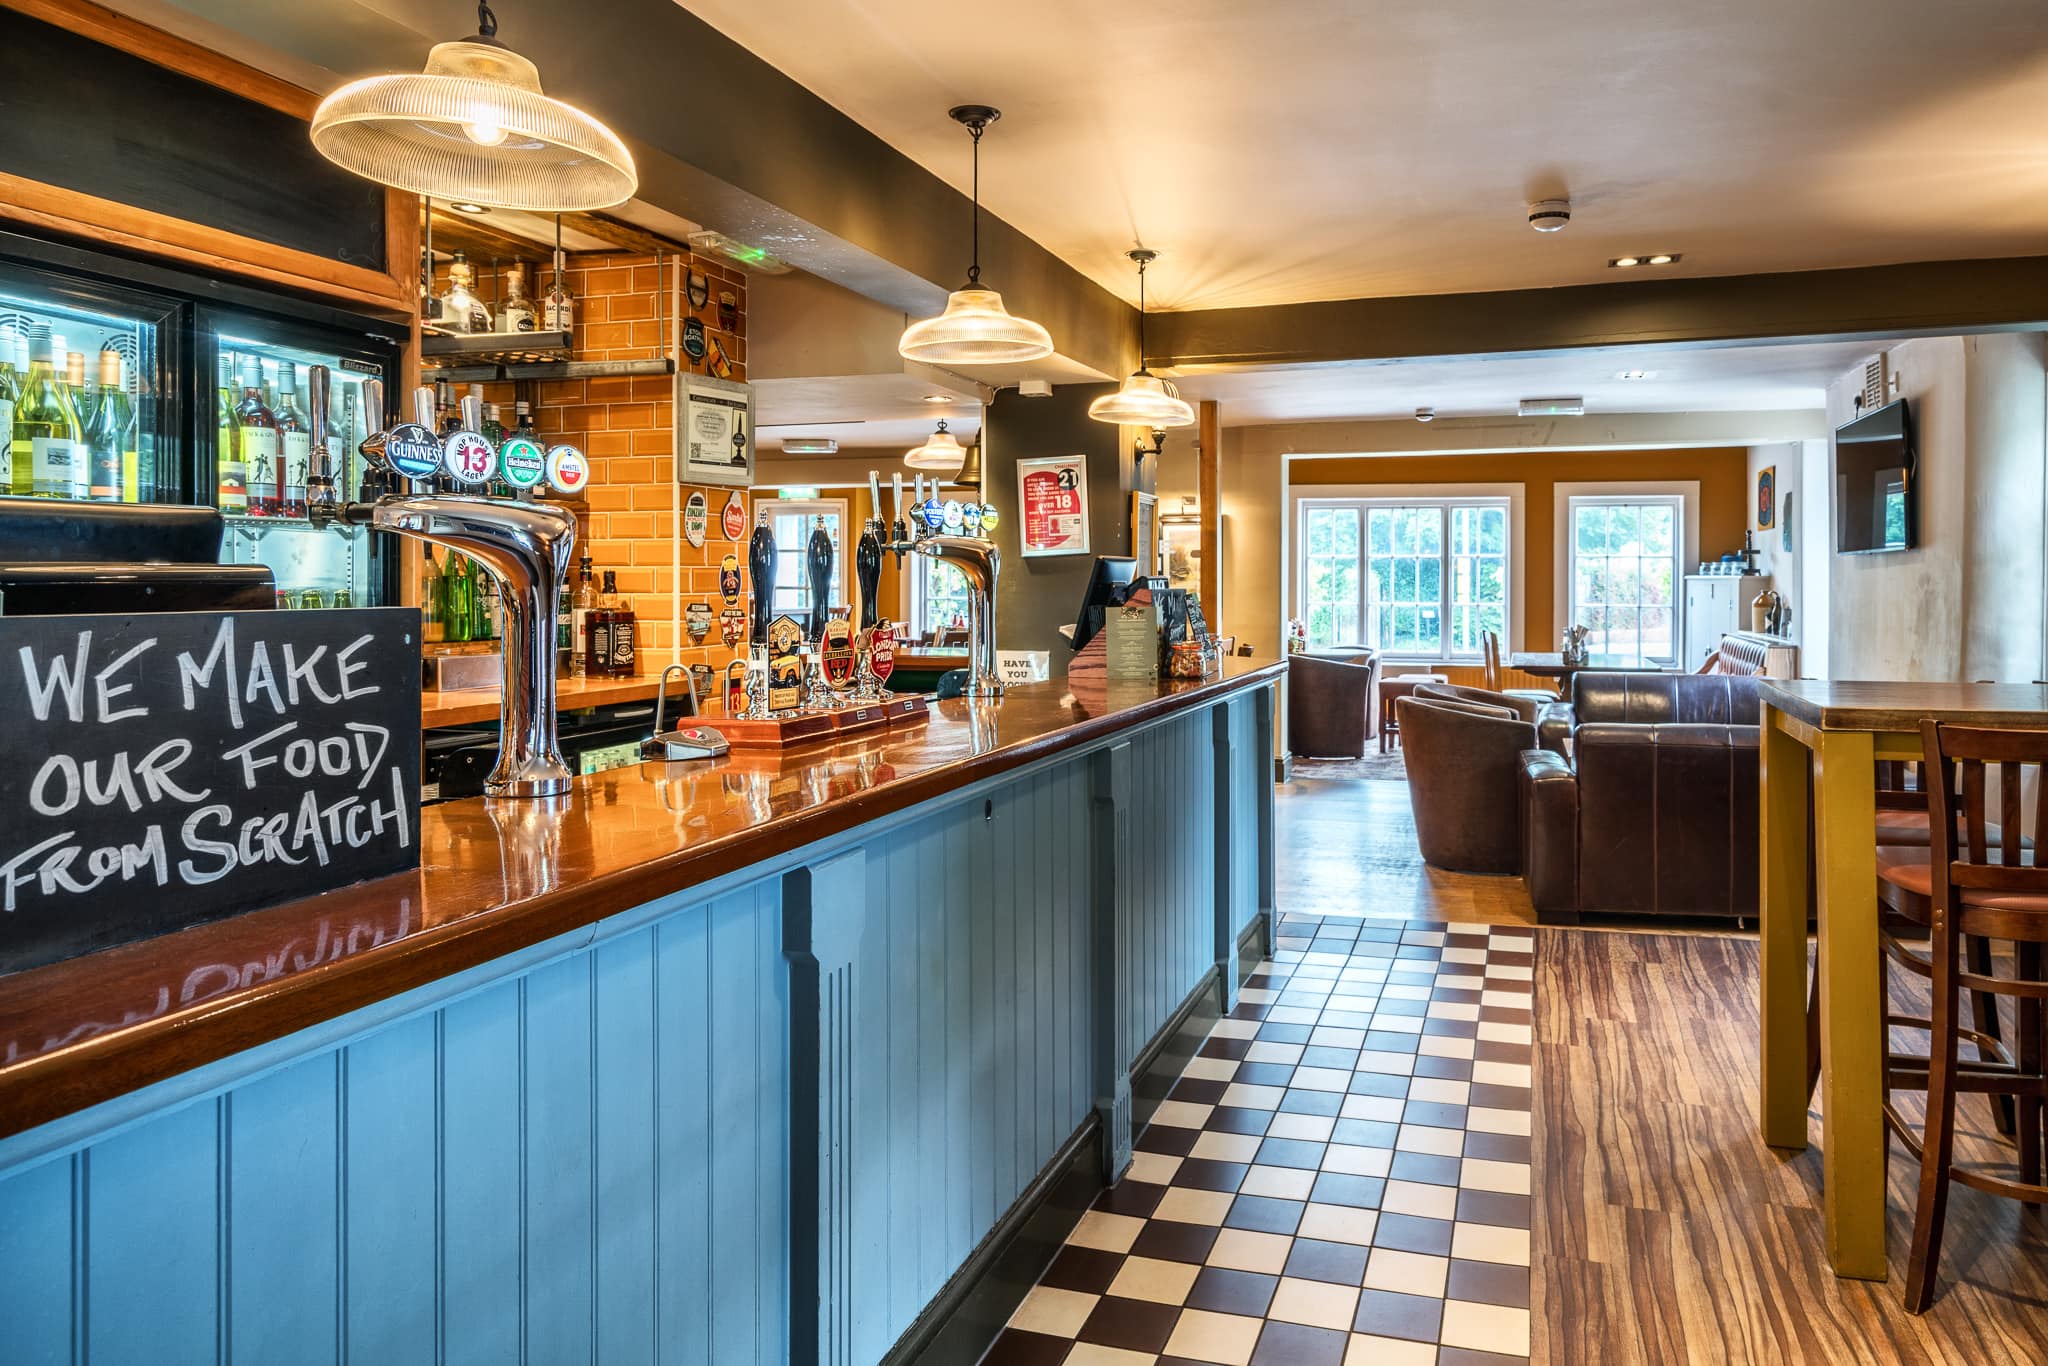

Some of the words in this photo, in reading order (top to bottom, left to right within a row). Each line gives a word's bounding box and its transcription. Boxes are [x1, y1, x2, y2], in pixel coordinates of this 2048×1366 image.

[343, 360, 378, 375] Blizzard
[391, 441, 442, 465] GUINNESS
[457, 438, 467, 456] HOP
[469, 436, 491, 458] HOUSE
[460, 446, 487, 473] 13
[507, 457, 541, 470] Heineken
[561, 463, 580, 472] AMSTEL
[461, 468, 485, 480] LAGER
[1058, 471, 1077, 487] 21
[1054, 495, 1072, 508] 18
[872, 639, 899, 655] LONDON
[830, 659, 848, 669] RED
[875, 651, 893, 662] PRIDE
[1003, 660, 1032, 668] HAVE
[18, 630, 158, 724] WE
[175, 616, 381, 729] MAKE
[29, 738, 212, 817] OUR
[221, 721, 391, 790] FOOD
[0, 825, 169, 912] FROM
[178, 766, 410, 886] SCRATCH
